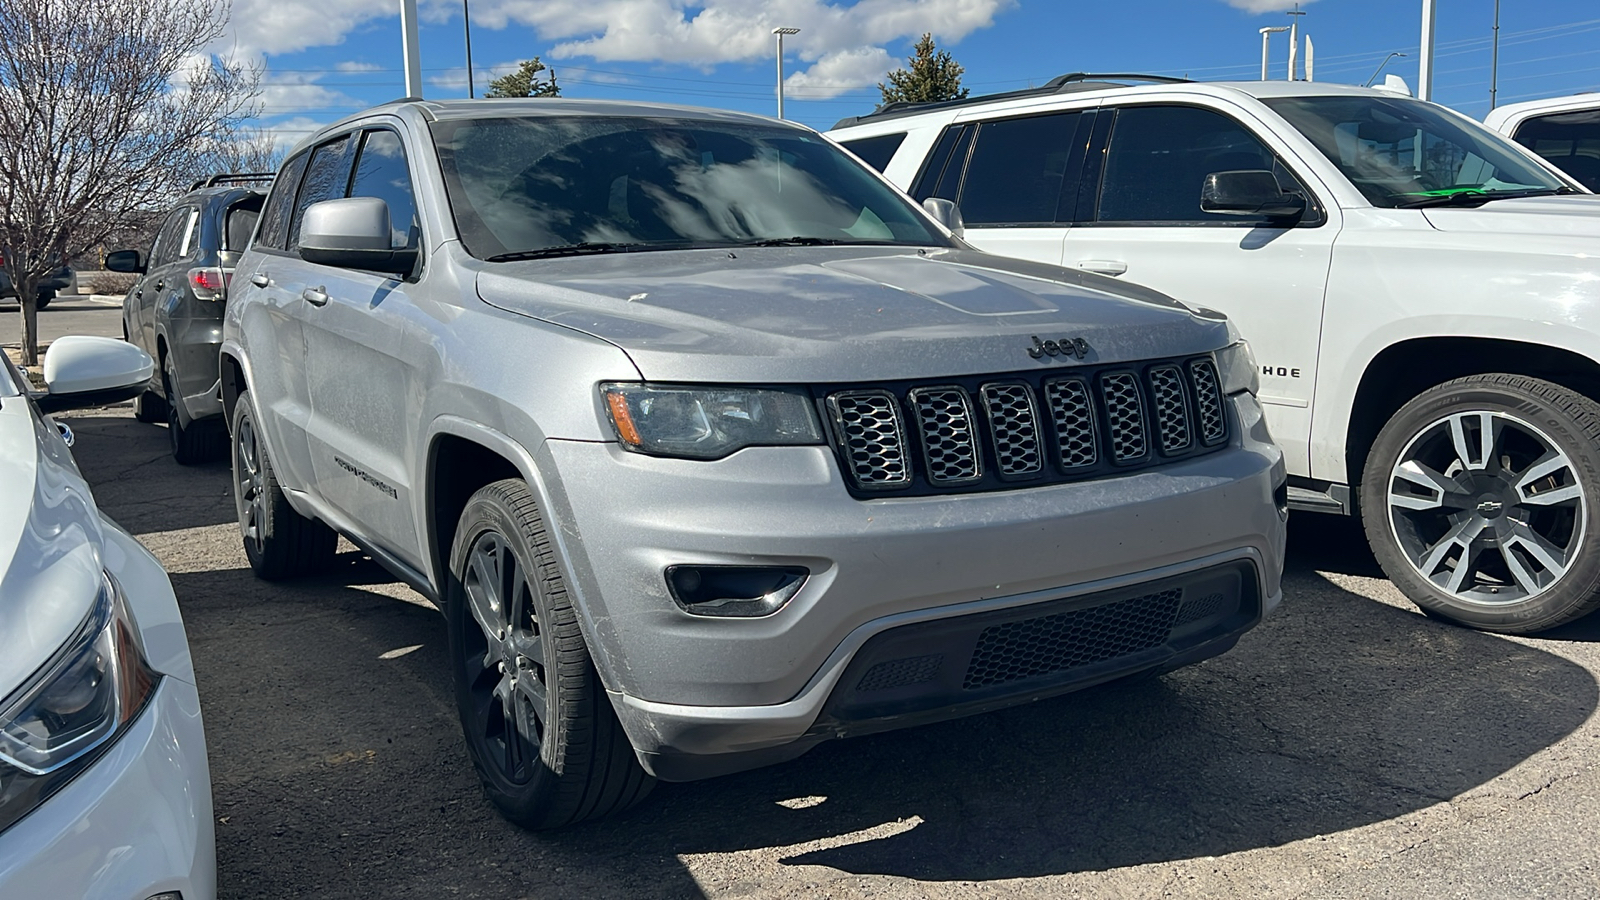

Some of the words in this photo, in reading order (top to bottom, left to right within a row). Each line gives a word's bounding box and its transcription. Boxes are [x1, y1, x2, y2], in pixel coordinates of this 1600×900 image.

[1027, 336, 1089, 359] Jeep
[1256, 365, 1301, 378] HOE
[1547, 419, 1582, 450] OPEN
